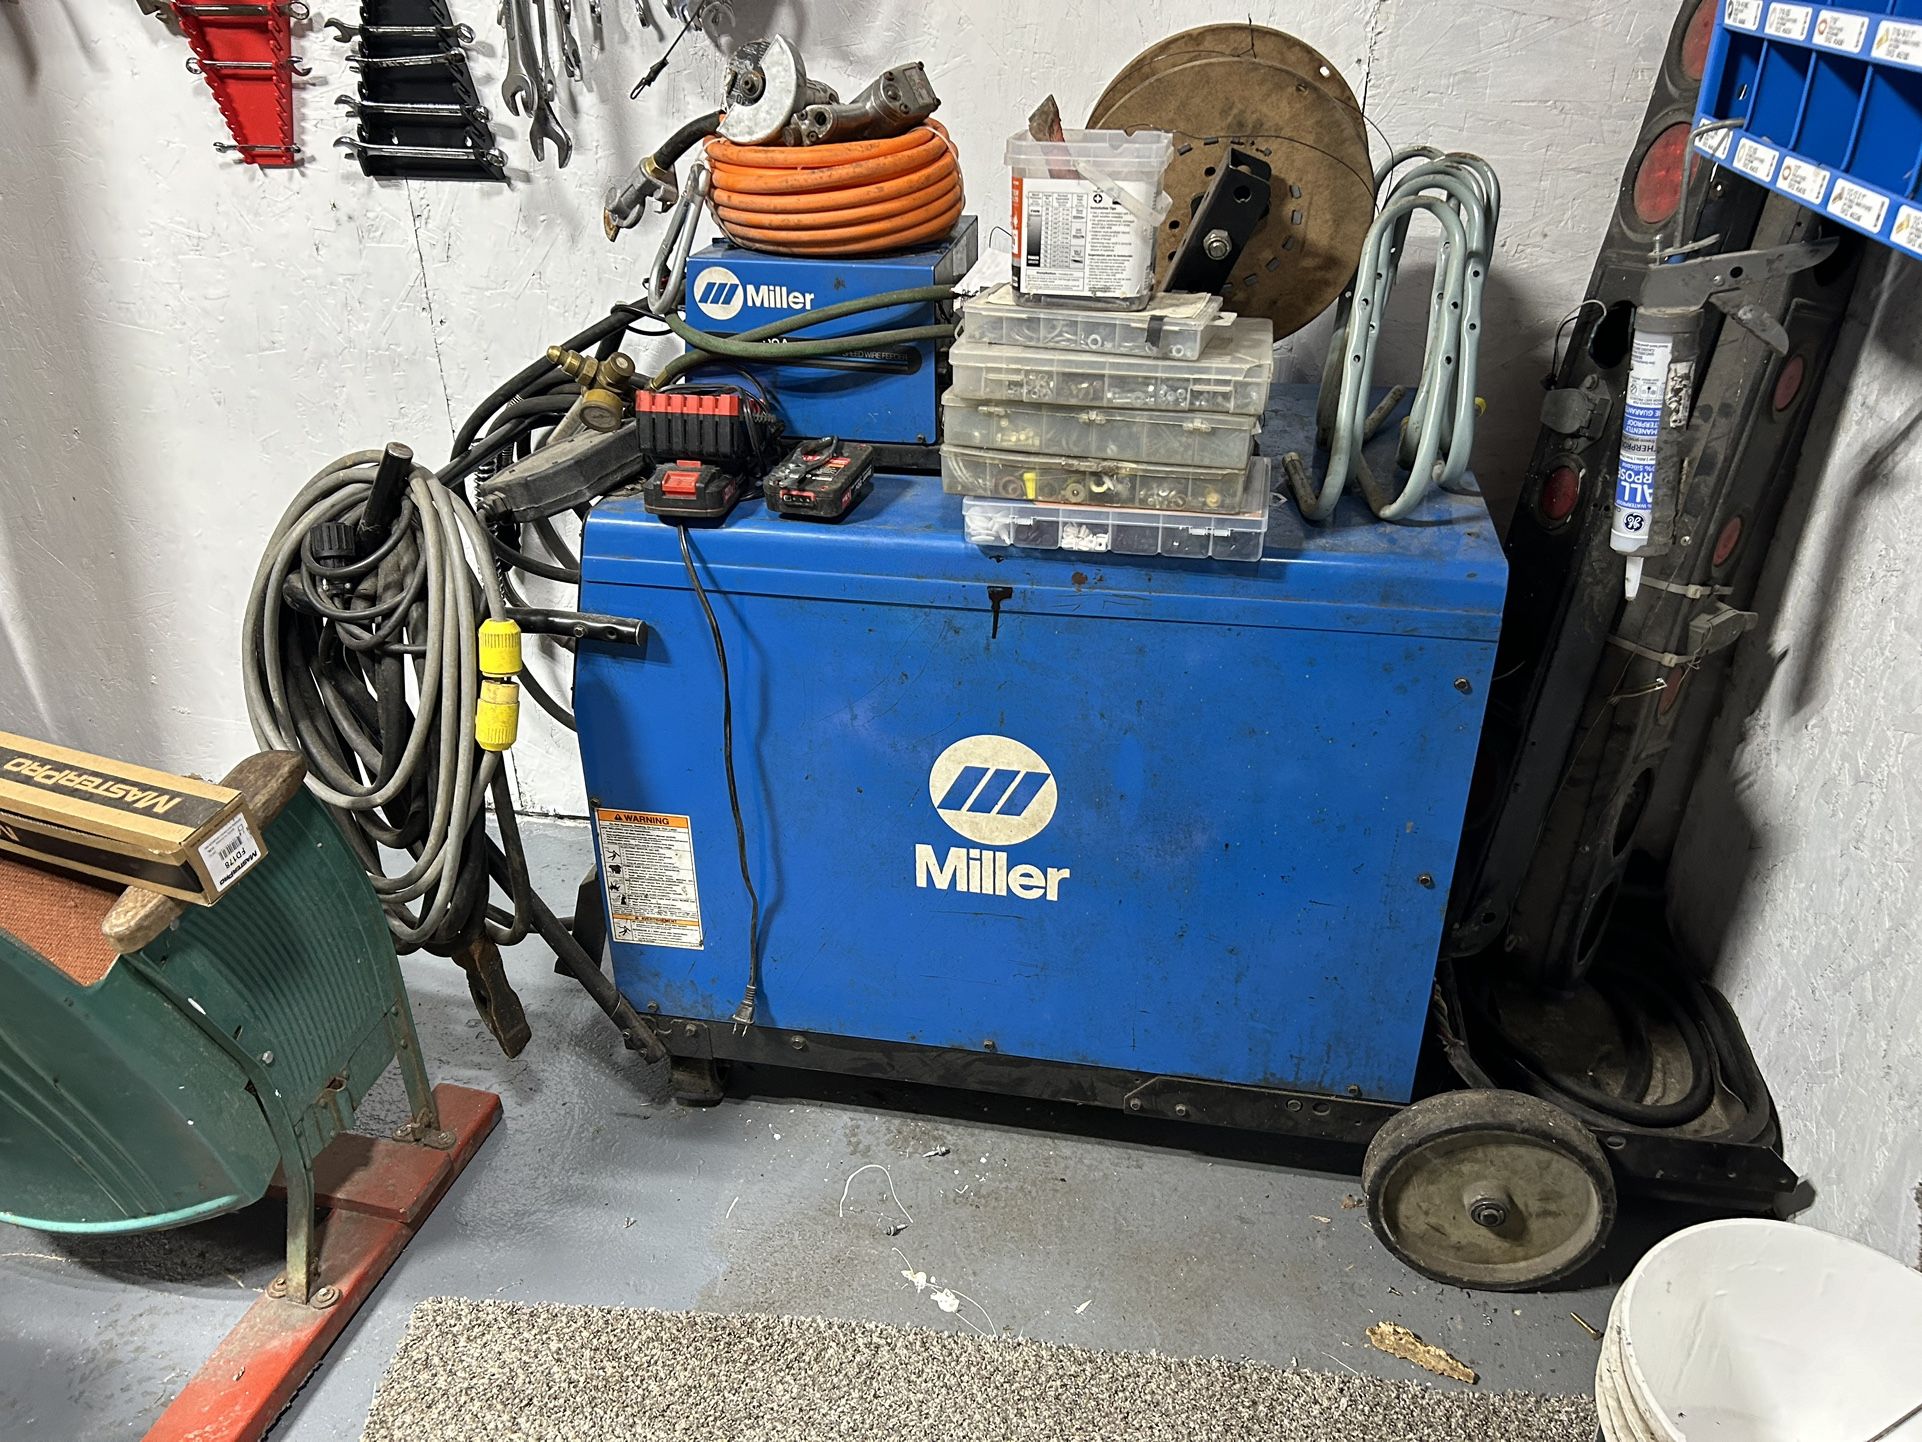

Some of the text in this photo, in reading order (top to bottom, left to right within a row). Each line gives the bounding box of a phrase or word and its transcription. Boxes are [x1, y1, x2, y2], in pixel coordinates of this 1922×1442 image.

[746, 284, 814, 310] Miller
[1621, 481, 1654, 502] ALL
[624, 814, 670, 825] WARNING
[224, 847, 246, 869] FD178
[914, 843, 1070, 902] Miller
